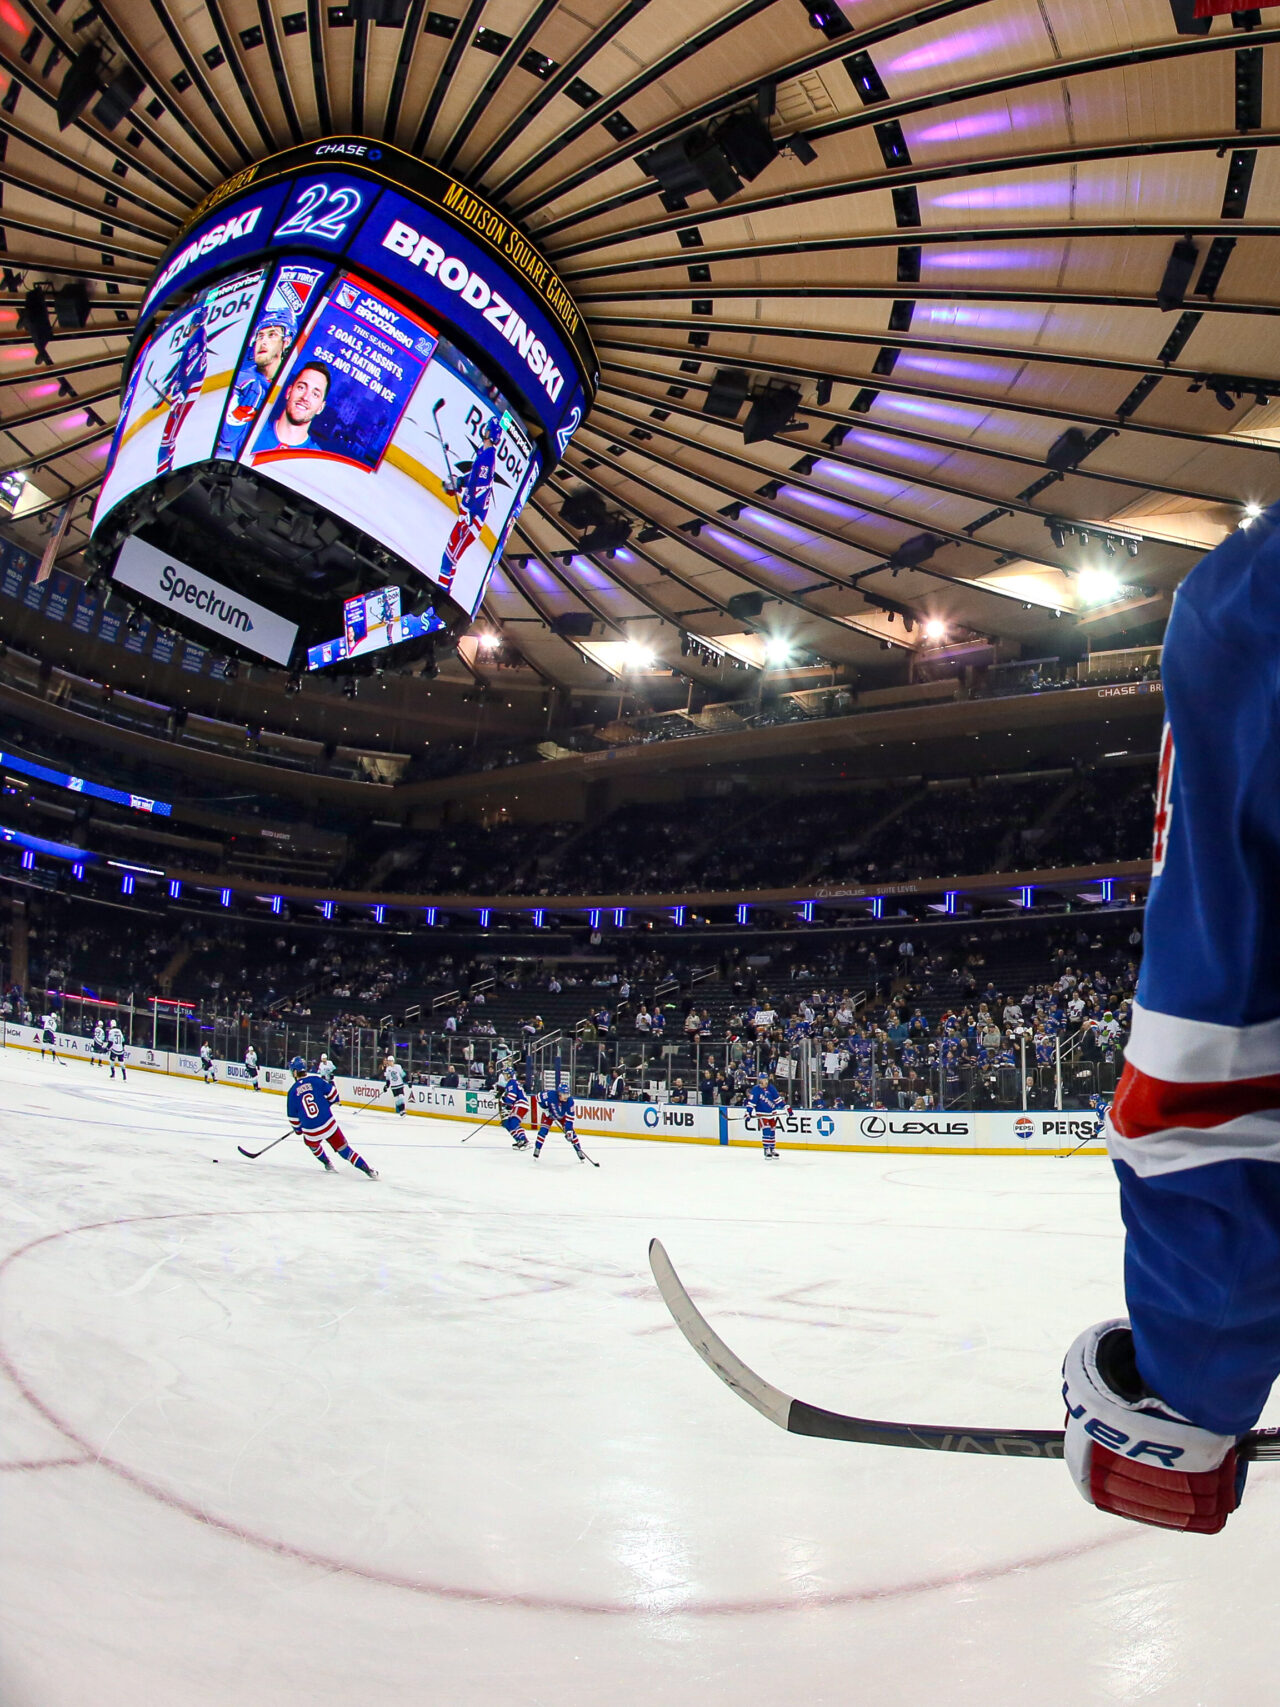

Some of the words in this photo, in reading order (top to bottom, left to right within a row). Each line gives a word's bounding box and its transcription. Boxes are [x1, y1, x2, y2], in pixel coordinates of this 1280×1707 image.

[316, 144, 368, 156] CHASE
[274, 183, 361, 239] 22
[442, 183, 508, 245] MADISON
[505, 232, 550, 289] SQUARE
[546, 276, 579, 335] GARDEN
[207, 275, 261, 298] enterprise
[295, 272, 315, 283] YORK
[360, 298, 400, 324] JONNY
[381, 219, 564, 404] BRODZINSKI
[354, 305, 414, 349] BRODZINSKI
[352, 324, 370, 340] THIS
[369, 336, 395, 355] SEASON
[414, 337, 433, 357] 22
[327, 324, 337, 336] 2
[334, 328, 364, 354] GOALS,
[364, 346, 373, 356] 2
[369, 350, 404, 381] ASSISTS,
[313, 346, 335, 364] 9:55
[332, 357, 351, 374] AVG
[351, 366, 372, 386] TIME
[369, 380, 384, 394] ON
[381, 387, 397, 404] ICE
[339, 348, 350, 360] +4
[350, 353, 382, 381] RATING,
[502, 418, 531, 457] enterprise
[159, 565, 251, 633] Spectrum
[1097, 686, 1136, 697] CHASE
[66, 776, 84, 792] 22
[829, 889, 866, 897] LEXUS
[876, 886, 896, 895] SUITE
[897, 885, 918, 893] LEVEL
[227, 1065, 239, 1077] BUD
[353, 1084, 380, 1098] verizon
[419, 1092, 455, 1106] DELTA
[301, 1093, 320, 1119] 6
[575, 1105, 616, 1121] UNKIN'
[663, 1111, 695, 1127] HUB
[745, 1116, 812, 1133] CASE
[889, 1122, 969, 1135] LEXUS
